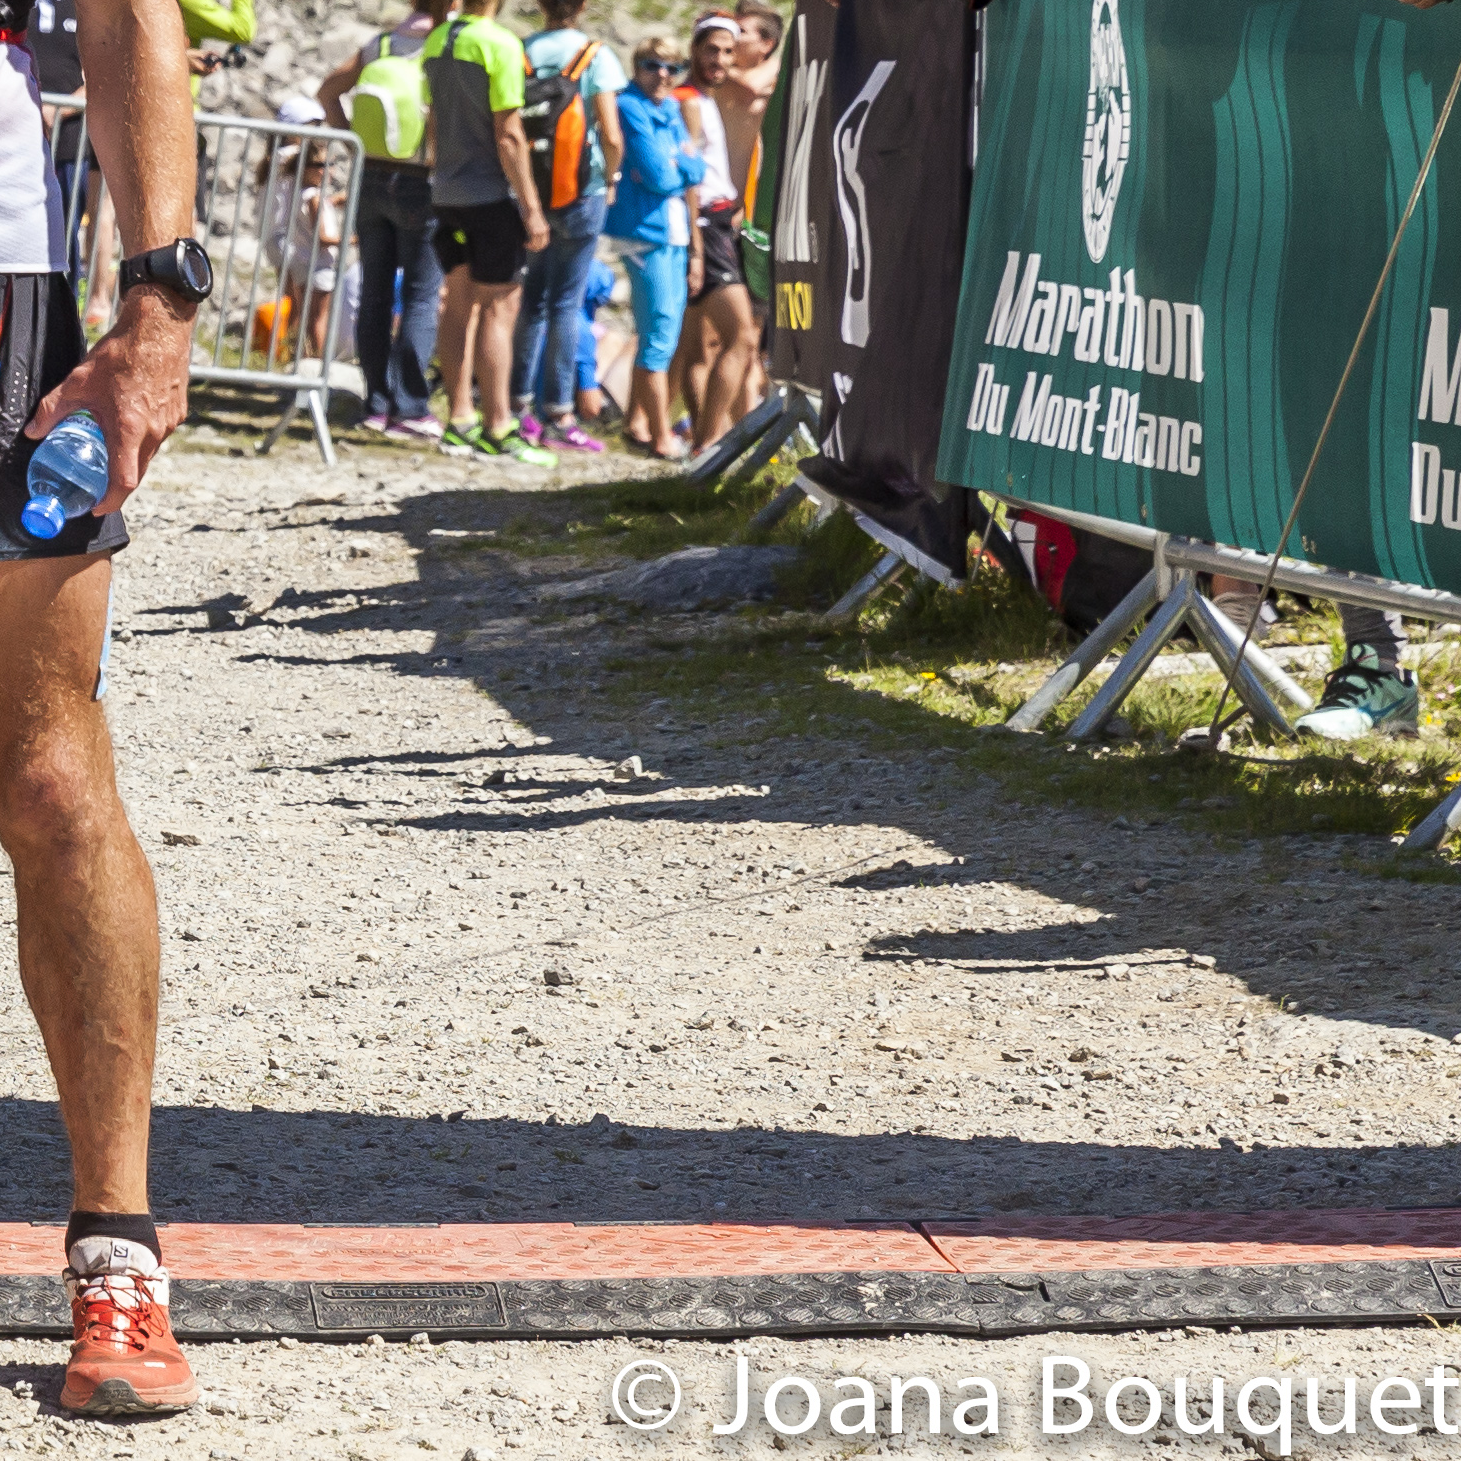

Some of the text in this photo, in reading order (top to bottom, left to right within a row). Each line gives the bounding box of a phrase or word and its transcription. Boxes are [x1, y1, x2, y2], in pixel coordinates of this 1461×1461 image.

[983, 249, 1204, 384] Marathon
[966, 361, 1203, 478] Du Mont-Blanc
